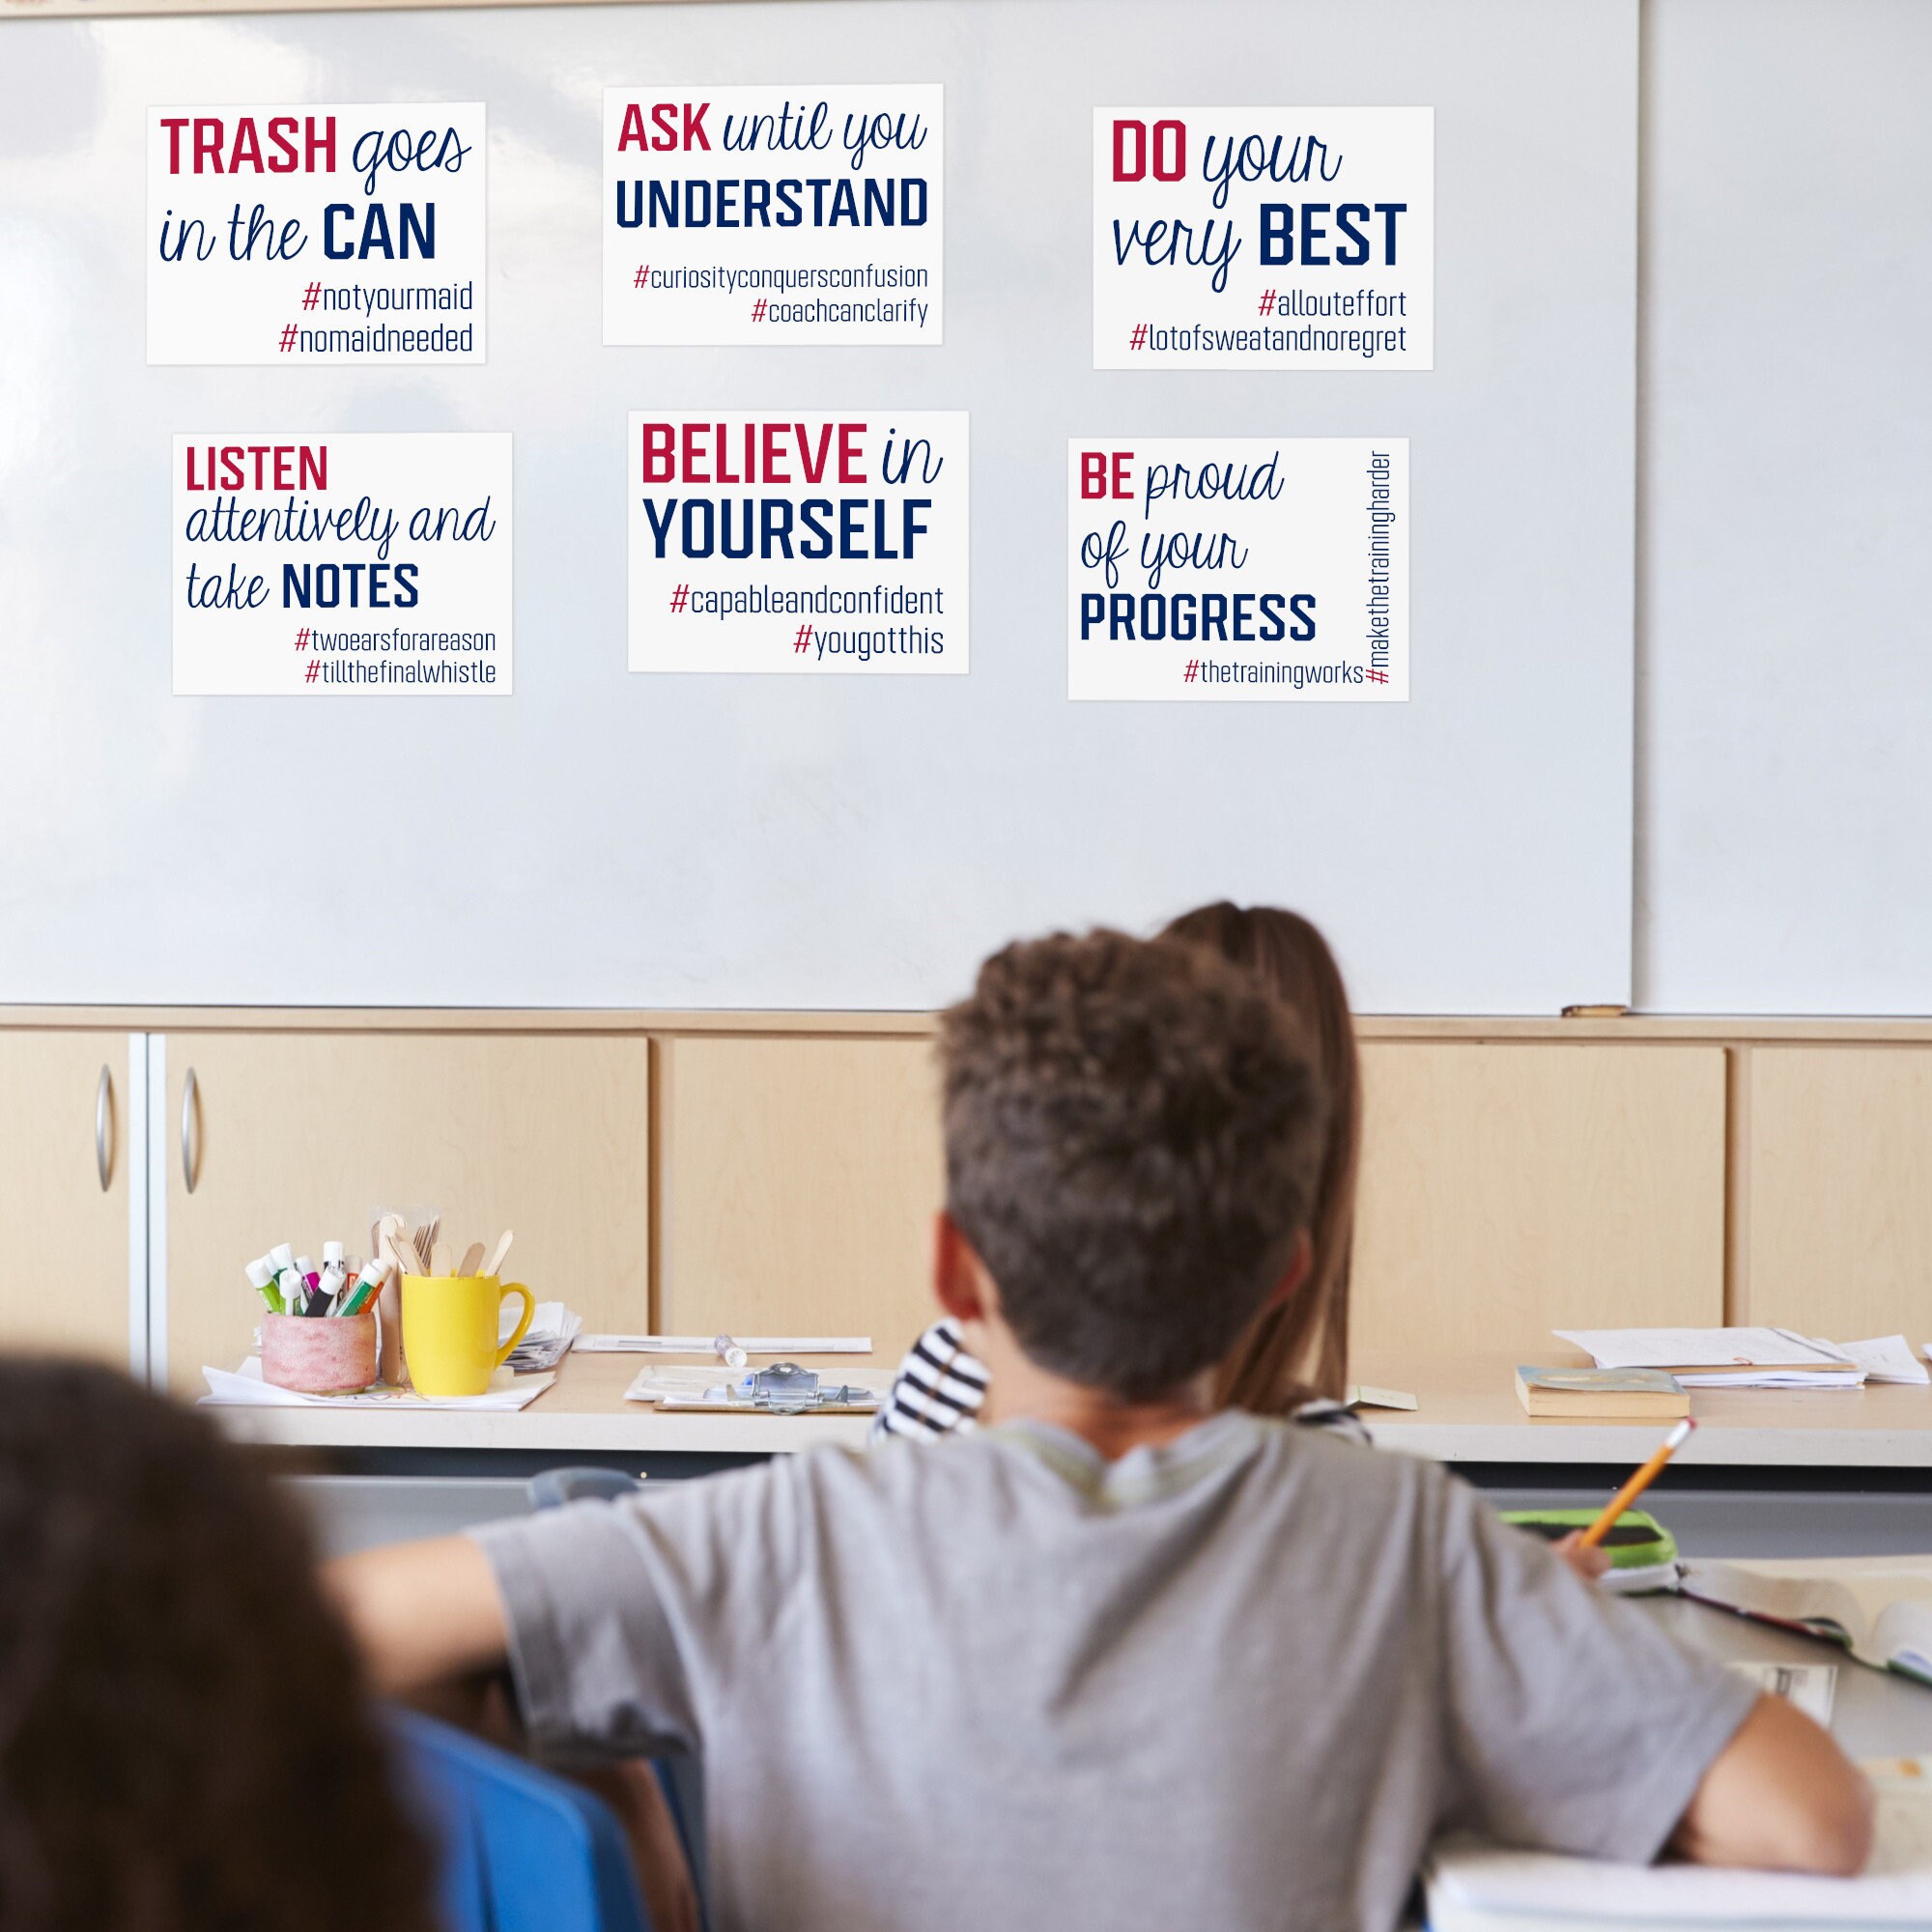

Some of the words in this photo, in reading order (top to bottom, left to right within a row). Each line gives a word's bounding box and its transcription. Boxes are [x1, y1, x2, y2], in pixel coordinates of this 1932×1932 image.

[160, 117, 335, 174] TRASH
[352, 127, 472, 196] goes
[618, 103, 711, 151] ASK
[723, 100, 834, 152] until
[842, 112, 928, 171] you
[1113, 120, 1185, 182] DO
[1203, 134, 1344, 210] your
[617, 179, 926, 228] UNDERSTAND
[159, 209, 216, 262] in
[227, 203, 308, 262] the
[325, 203, 435, 259] CAN
[1112, 218, 1242, 294] very
[1261, 204, 1406, 266] BEST
[301, 281, 472, 317] #notyourmaid
[633, 264, 927, 294] #curiosityconquersconfusion
[751, 298, 927, 327] #coachcanclarify
[1258, 290, 1406, 316] #allouteffort
[278, 324, 472, 352] #nomaidneeded
[1129, 325, 1406, 357] #lotofsweatandnoregret
[186, 446, 327, 491] LISTEN
[643, 424, 867, 483] BELIEVE
[882, 427, 944, 485] in
[1082, 452, 1134, 498] BE
[1145, 450, 1285, 521] proud
[185, 495, 400, 561] attentively
[409, 495, 497, 542] and
[642, 498, 931, 558] YOURSELF
[1081, 520, 1129, 589] of
[1140, 531, 1249, 590] your
[1366, 450, 1395, 684] #makethetrainingharder
[185, 562, 270, 611] take
[283, 564, 418, 608] NOTES
[669, 584, 944, 620] #capableandconfident
[294, 628, 496, 650] #twoearsforareason
[1082, 594, 1316, 640] PROGRESS
[793, 625, 944, 661] #yougotthis
[304, 660, 496, 682] #tillthefinalwhistle
[1183, 660, 1364, 689] #thetrainingworks
